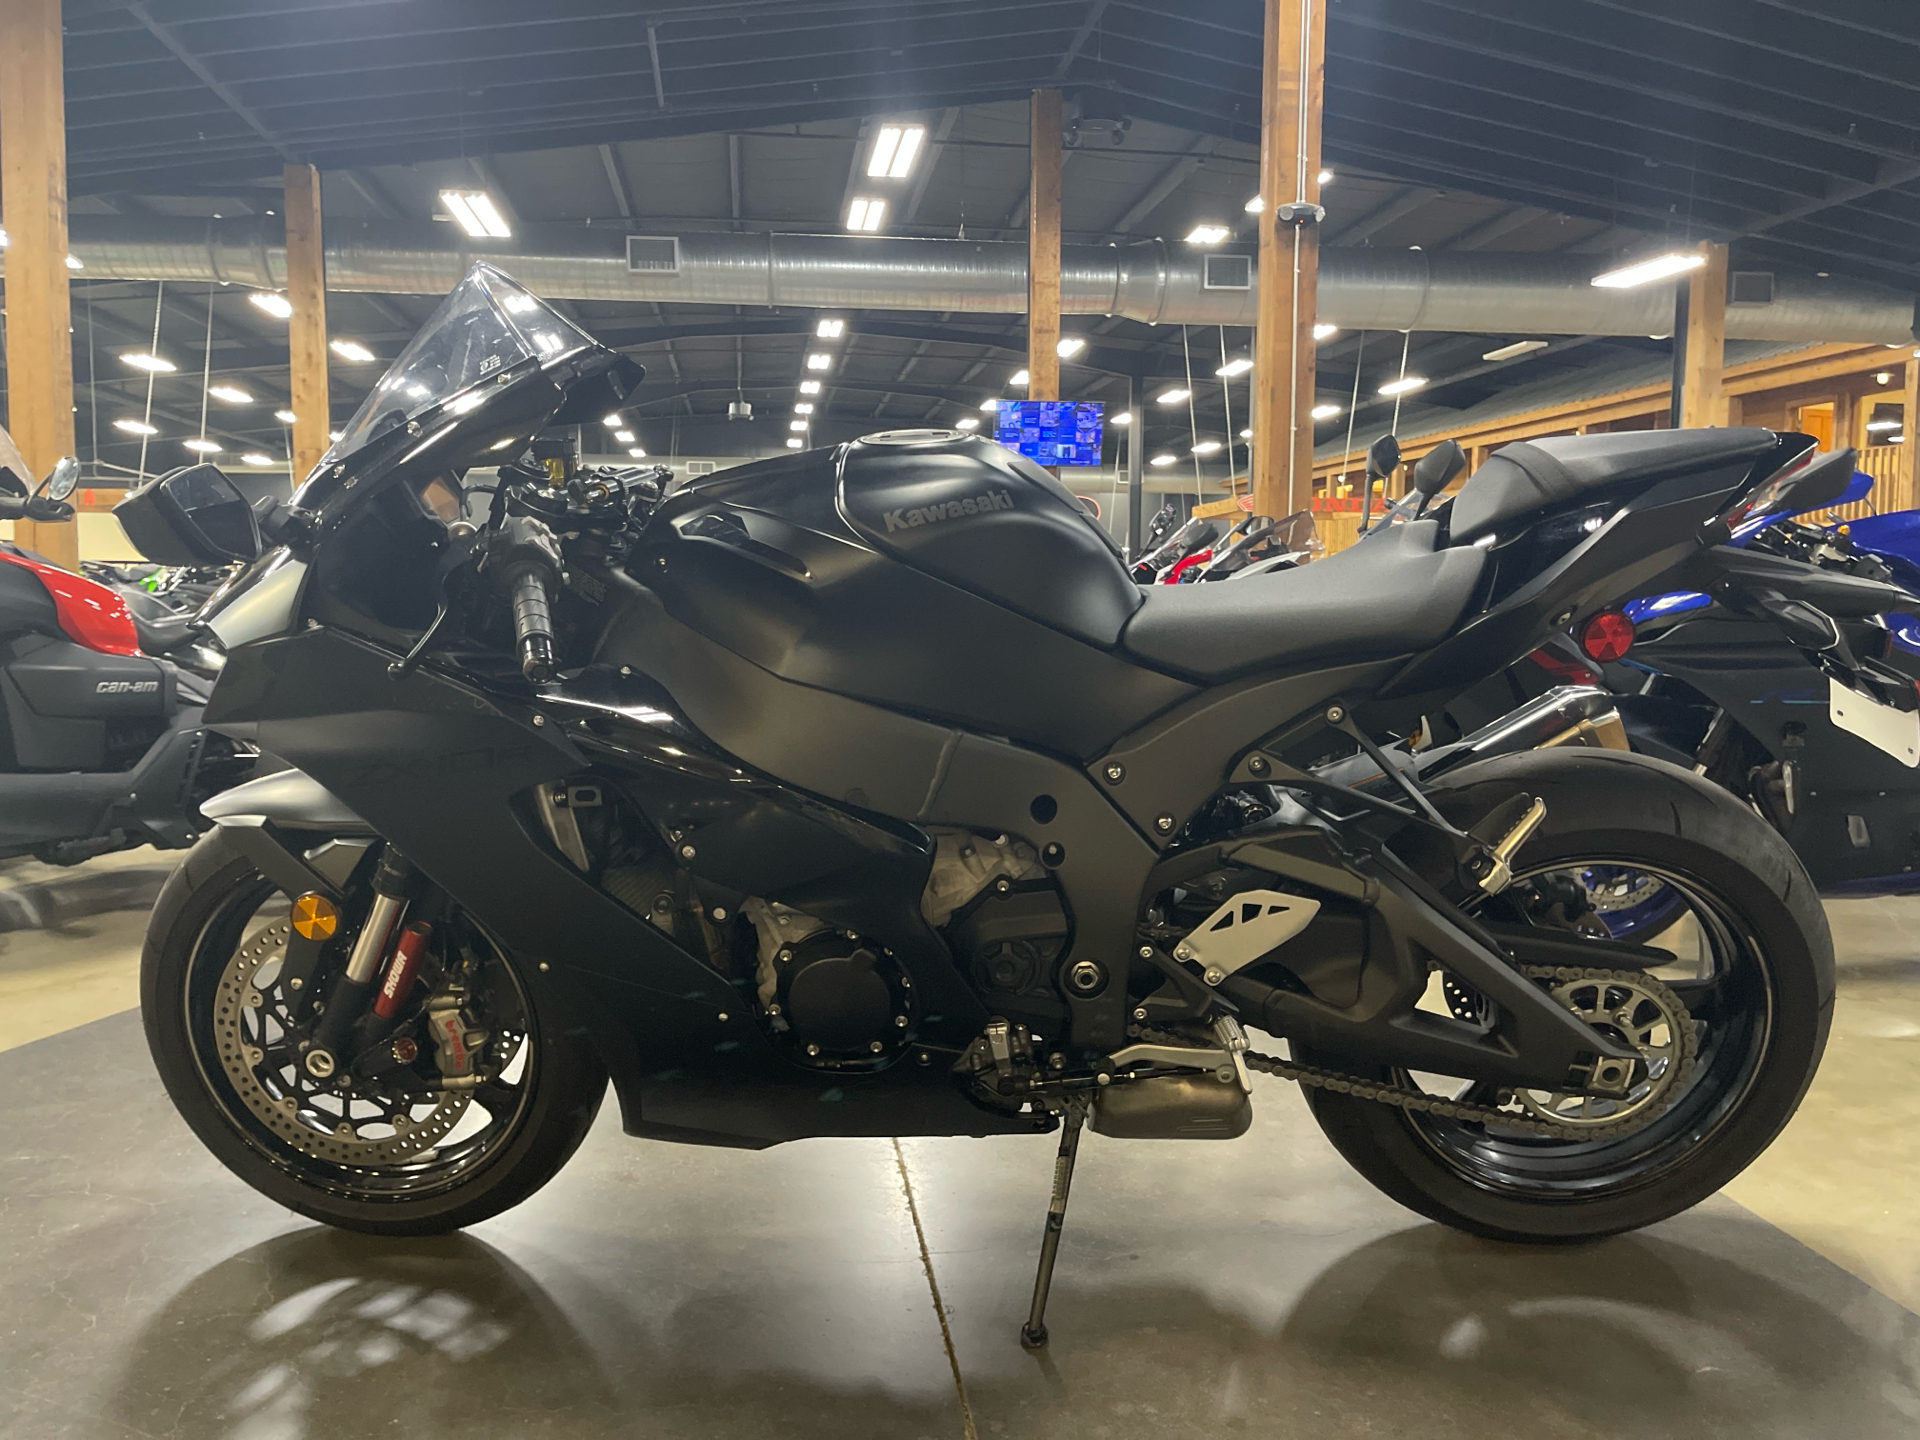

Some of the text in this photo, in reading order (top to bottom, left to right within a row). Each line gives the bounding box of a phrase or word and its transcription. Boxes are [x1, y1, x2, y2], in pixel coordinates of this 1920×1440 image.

[883, 490, 1014, 532] Kawasaki
[1311, 497, 1390, 512] ONDA
[96, 681, 158, 693] can-am
[384, 950, 407, 999] SHOWA
